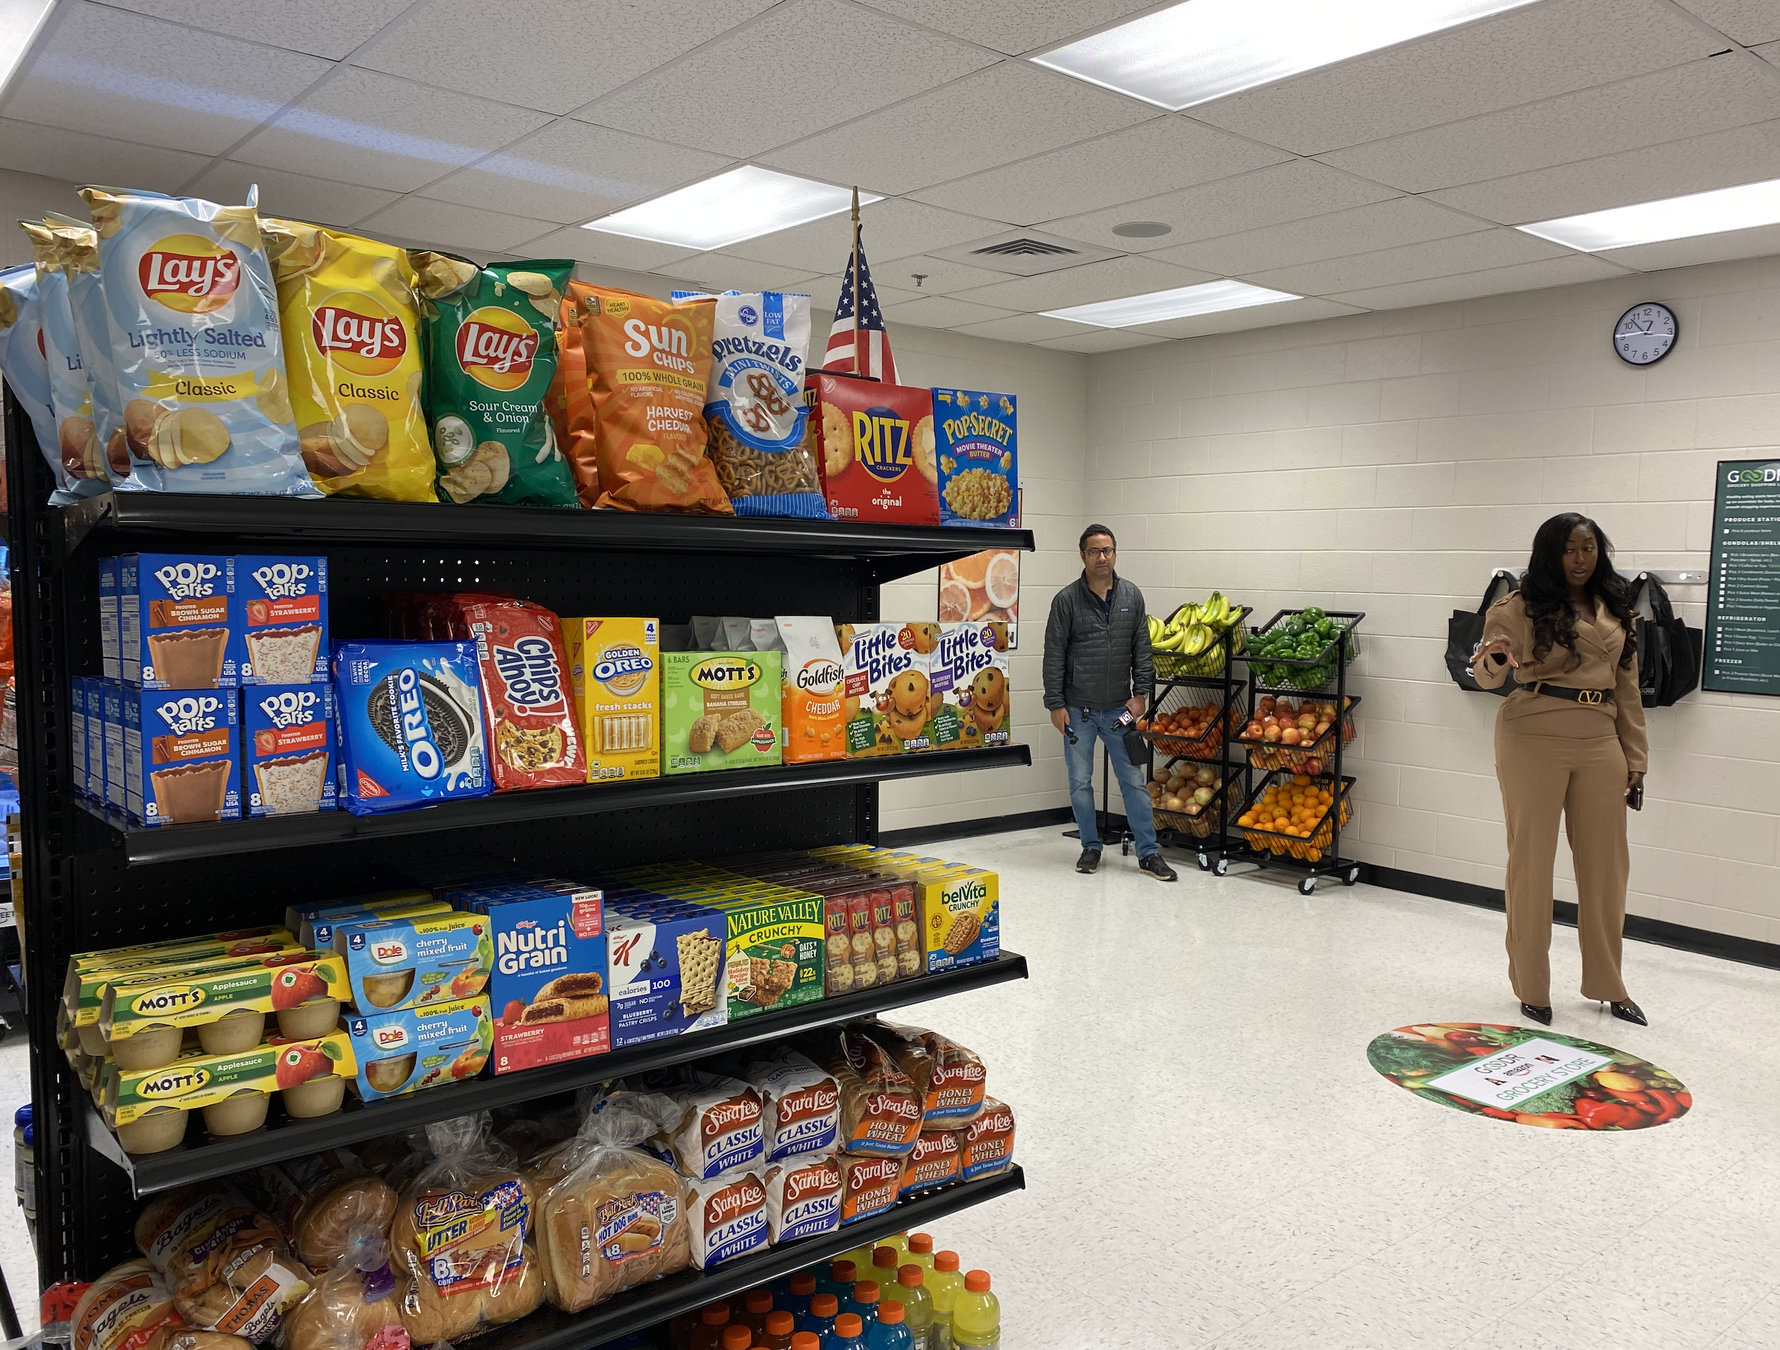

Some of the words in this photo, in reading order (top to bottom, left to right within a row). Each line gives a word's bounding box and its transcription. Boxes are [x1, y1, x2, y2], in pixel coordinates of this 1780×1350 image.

[147, 253, 234, 297] Lay's
[764, 311, 782, 319] LOW
[1643, 308, 1652, 316] 12
[766, 317, 780, 325] FAT
[129, 327, 197, 349] Lightly
[205, 328, 266, 348] Salted
[321, 308, 401, 358] Lay's
[624, 319, 687, 357] Sun
[176, 349, 201, 359] LESS
[203, 349, 246, 360] SODIUM
[463, 323, 534, 373] Lay's
[712, 335, 802, 373] Pretzels
[1632, 350, 1637, 358] 7
[1654, 348, 1659, 356] 5
[653, 352, 694, 374] CHIPS
[1642, 352, 1648, 360] 6
[728, 359, 749, 378] MINI
[751, 359, 791, 389] TWISTS
[175, 381, 237, 396] Classic
[622, 372, 651, 381] 100%
[653, 372, 681, 385] WHOLE
[683, 379, 704, 392] GRAIN
[339, 383, 399, 401] Classic
[469, 401, 499, 412] Sour
[502, 401, 538, 413] Cream
[647, 406, 693, 421] HARVEST
[483, 413, 493, 423] &
[495, 412, 529, 423] Onion
[853, 411, 913, 465] RITZ
[956, 443, 975, 453] MOVIE
[976, 443, 1002, 456] THEATER
[872, 496, 902, 509] original
[171, 609, 198, 617] BROWN
[178, 613, 220, 622] CINNAMON
[270, 607, 316, 617] STRAWBERRY
[647, 624, 654, 632] 4
[902, 630, 911, 640] 20
[982, 629, 992, 639] 20
[605, 649, 640, 659] GOLDEN
[854, 629, 896, 670] Little
[940, 629, 978, 667] Little
[241, 663, 252, 676] 8
[516, 638, 560, 703] Chips
[595, 659, 652, 681] OREO
[869, 652, 912, 684] Bites
[953, 650, 992, 680] Bites
[143, 667, 155, 680] 8
[698, 667, 755, 681] MOTT'S
[797, 664, 844, 689] Goldfish
[387, 675, 396, 704] COOKIE
[596, 702, 621, 711] fresh
[623, 702, 652, 710] stacks
[806, 700, 840, 714] CHEDDAR
[391, 706, 402, 745] FAVORITE
[400, 669, 440, 779] OREO
[173, 743, 201, 752] BROWN
[202, 739, 227, 747] SUGAR
[278, 733, 323, 745] STRAWBERRY
[181, 746, 222, 756] CINNAMON
[398, 746, 409, 772] MILK'S
[250, 794, 261, 806] 8
[146, 803, 158, 816] 8
[941, 882, 987, 905] belVita
[896, 901, 912, 919] RITZ
[948, 900, 980, 912] CRUNCHY
[728, 908, 777, 939] NATURE
[778, 901, 820, 922] VALLEY
[827, 912, 846, 928] RITZ
[852, 910, 870, 927] RITZ
[874, 905, 892, 923] RITZ
[354, 935, 361, 943] 4
[498, 920, 565, 957] Nutri
[749, 926, 802, 943] CRUNCHY
[416, 937, 447, 949] cherry
[417, 945, 445, 957] mixed
[448, 943, 467, 953] fruit
[613, 933, 643, 966] K
[378, 945, 402, 958] Dole
[800, 949, 817, 960] HONEY
[499, 947, 567, 974] Grain
[212, 978, 258, 991] Applesauce
[619, 986, 647, 996] calories
[653, 980, 670, 989] 100
[139, 991, 200, 1012] MOTT'S
[214, 994, 234, 1002] APPLE
[623, 1009, 653, 1019] BLUEBERRY
[355, 1021, 363, 1029] 4
[417, 1021, 447, 1032] cherry
[619, 1019, 637, 1028] PASTRY
[380, 1030, 404, 1042] Dole
[418, 1030, 446, 1040] mixed
[448, 1025, 467, 1035] fruit
[501, 1029, 544, 1042] STRAWBERRY
[217, 1057, 262, 1071] Applesauce
[501, 1057, 508, 1066] 8
[143, 1072, 204, 1094] MOTT'S
[218, 1073, 238, 1082] APPLE
[1496, 1073, 1558, 1100] GROCERY
[1551, 1057, 1595, 1076] STORE
[938, 1088, 975, 1099] HONEY
[936, 1097, 973, 1107] WHEAT
[777, 1116, 832, 1144] CLASSIC
[870, 1122, 909, 1133] HONEY
[708, 1124, 760, 1159] CLASSIC
[866, 1129, 906, 1142] WHEAT
[787, 1138, 823, 1155] WHITE
[971, 1139, 1006, 1154] HONEY
[719, 1150, 754, 1169] WHITE
[971, 1148, 1006, 1163] WHEAT
[916, 1159, 952, 1174] HONEY
[915, 1168, 952, 1182] WHEAT
[857, 1185, 892, 1203] HONEY
[785, 1195, 838, 1224] CLASSIC
[856, 1194, 892, 1213] WHEAT
[709, 1210, 764, 1247] CLASSIC
[794, 1220, 829, 1236] WHITE
[611, 1244, 620, 1255] 8
[721, 1236, 757, 1258] WHITE
[245, 1300, 276, 1335] Bagels
